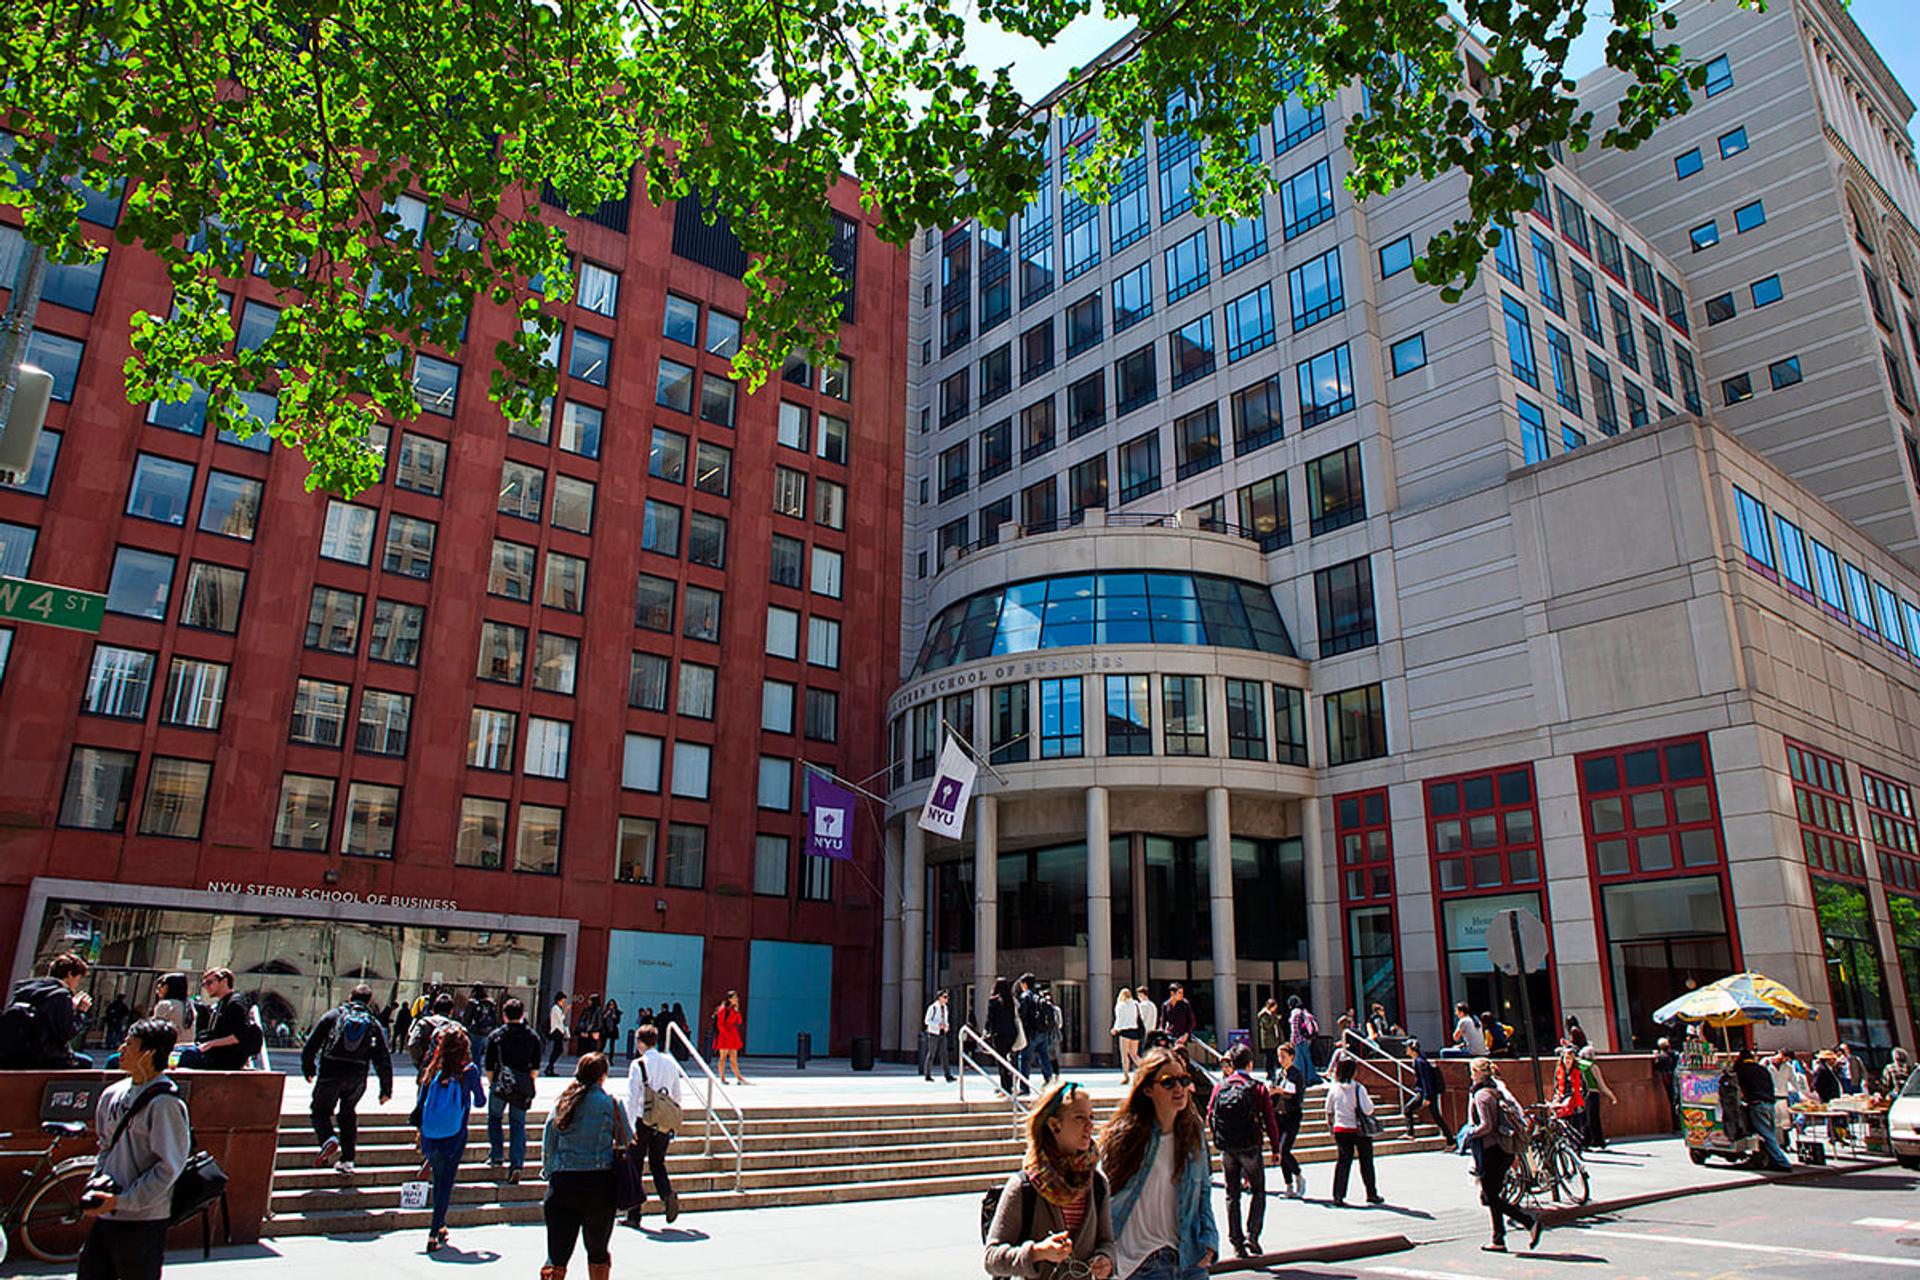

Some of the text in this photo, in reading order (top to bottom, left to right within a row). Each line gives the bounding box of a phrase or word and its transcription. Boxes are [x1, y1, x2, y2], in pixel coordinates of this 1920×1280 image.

[28, 590, 54, 619] 4
[64, 594, 91, 612] ST
[931, 671, 987, 694] SCHOOL
[995, 666, 1015, 680] OF
[1023, 656, 1125, 675] BUSINESS
[927, 806, 955, 826] NYU
[814, 836, 843, 850] NYU
[207, 881, 458, 911] NYU STERN SCHOOL OF BUSINESS
